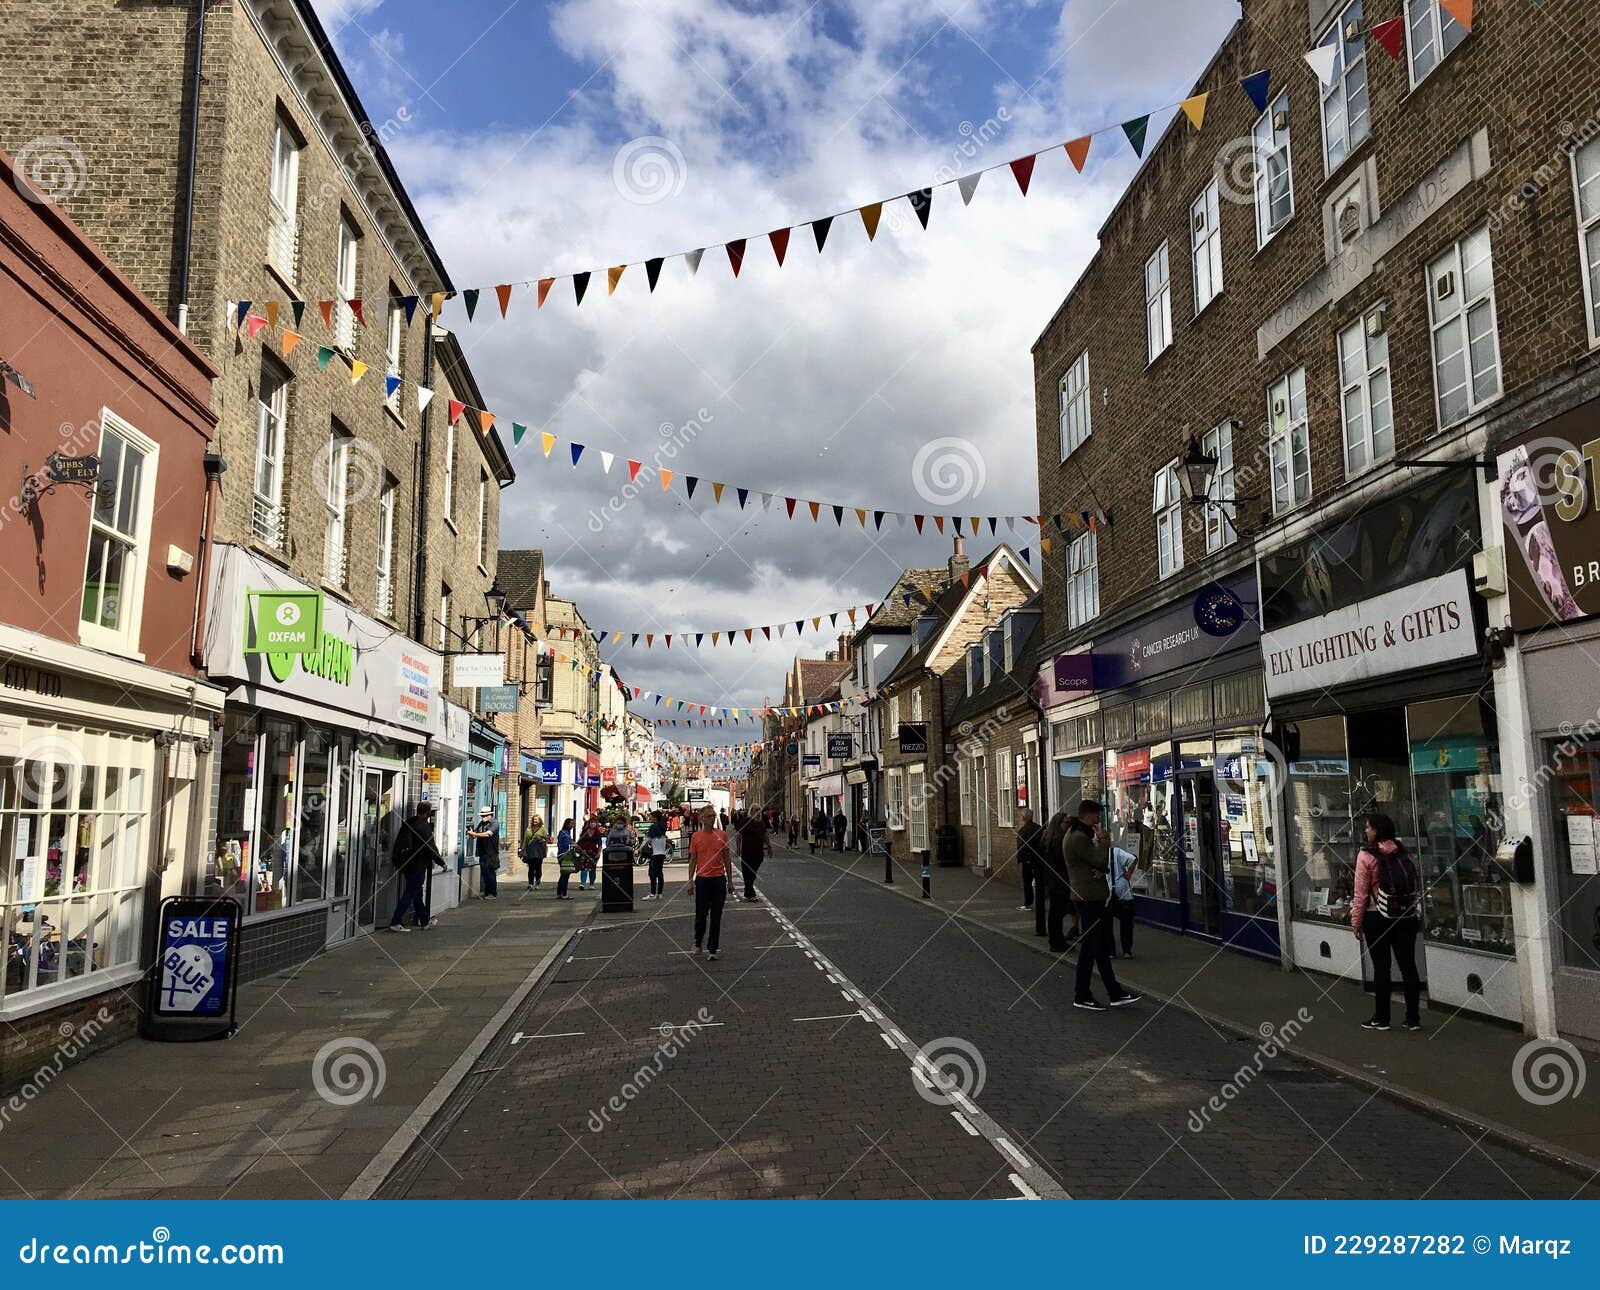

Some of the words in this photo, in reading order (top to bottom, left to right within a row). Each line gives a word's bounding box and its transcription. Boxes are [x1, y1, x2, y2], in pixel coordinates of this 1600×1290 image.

[1274, 233, 1373, 335] CORONATION
[1387, 167, 1451, 242] PARADE
[56, 460, 83, 469] GIBBS
[77, 468, 94, 476] ELY
[268, 631, 306, 642] OXFAM
[1142, 640, 1163, 658] CANCER
[1163, 630, 1190, 652] RESEARCH
[1190, 626, 1200, 641] UK
[1269, 648, 1294, 676] ELY
[1298, 625, 1377, 669] LIGHTING
[1383, 620, 1397, 647] &
[1401, 601, 1461, 642] GIFTS
[1058, 676, 1088, 687] Scope
[485, 702, 514, 710] BOOKS
[168, 920, 228, 939] SALE
[164, 952, 209, 994] BLUE
